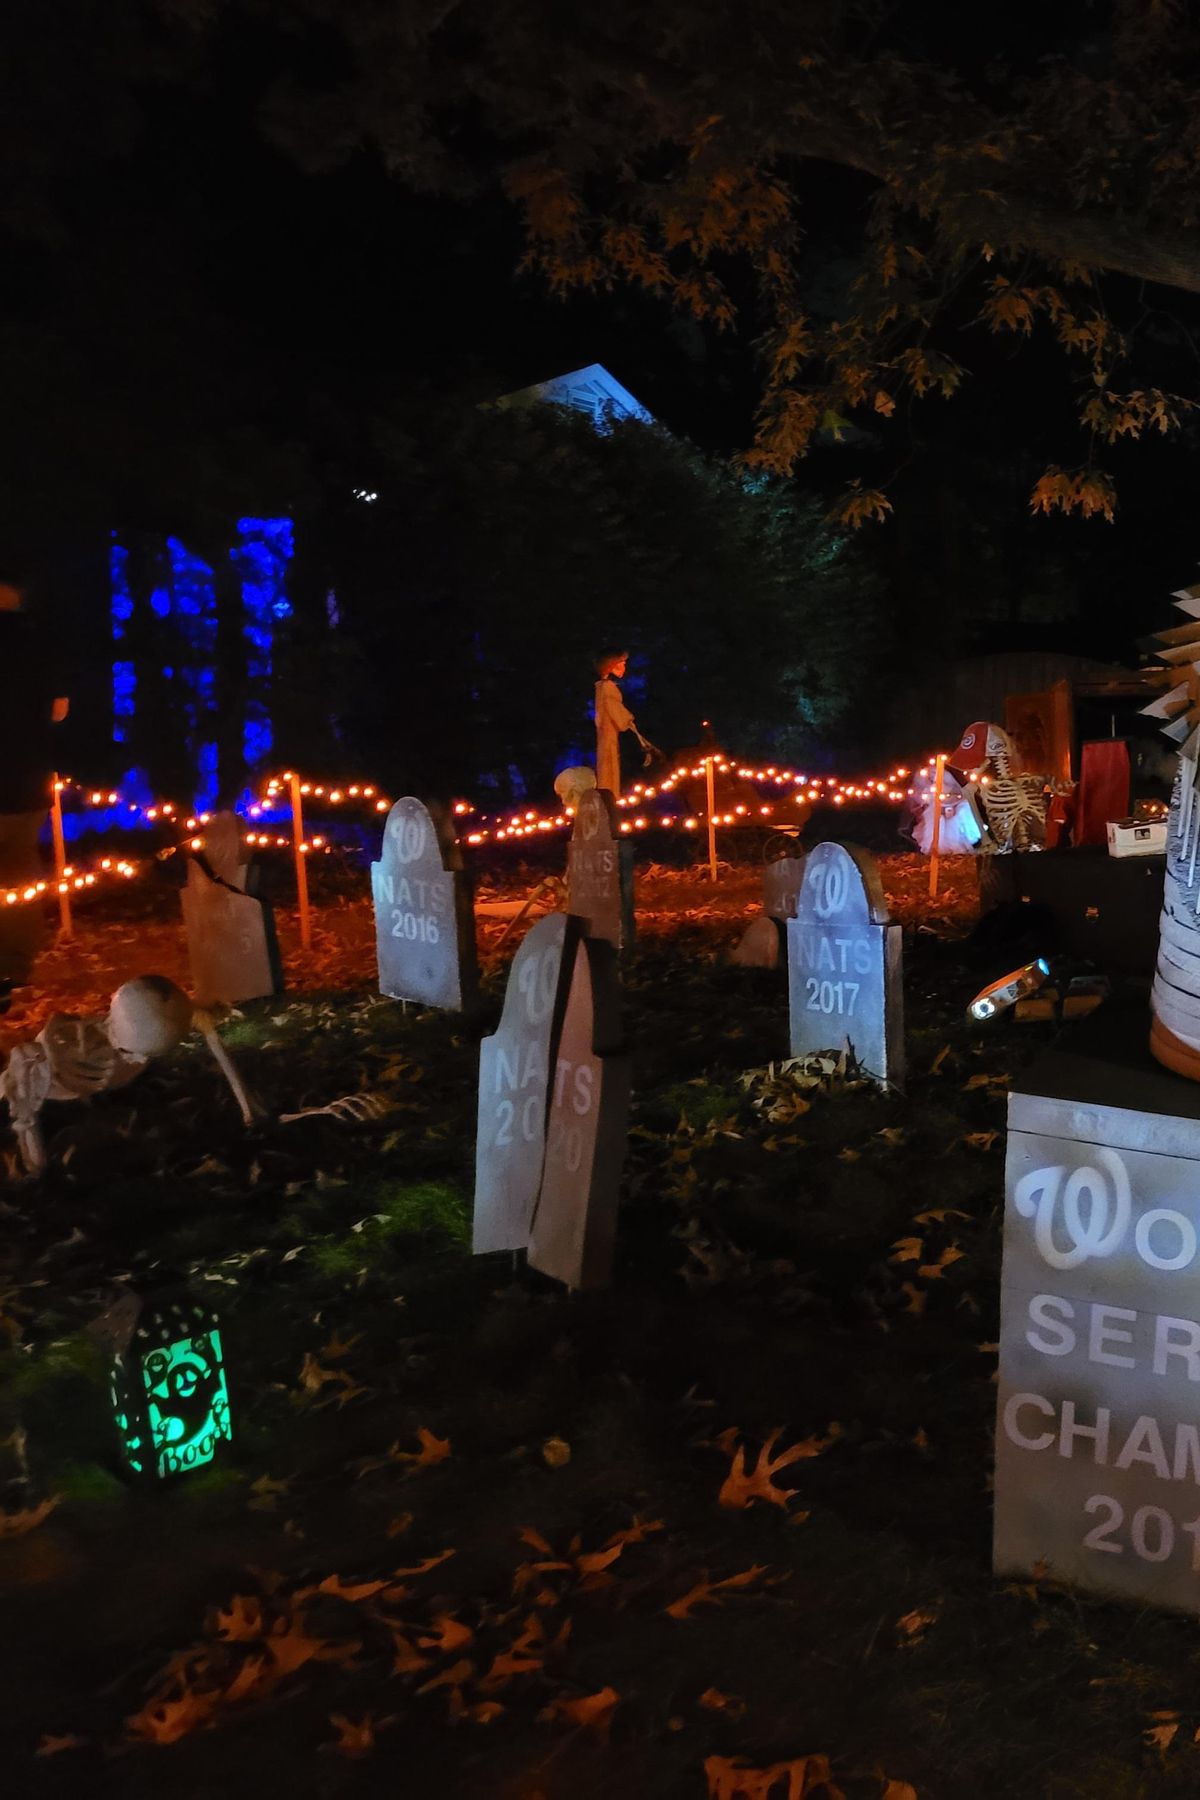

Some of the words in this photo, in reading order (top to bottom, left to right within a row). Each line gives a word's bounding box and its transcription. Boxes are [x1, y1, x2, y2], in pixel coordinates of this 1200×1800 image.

[376, 876, 446, 913] NATS
[391, 909, 440, 944] 2016
[796, 936, 873, 975] NATS
[806, 977, 860, 1016] 2017
